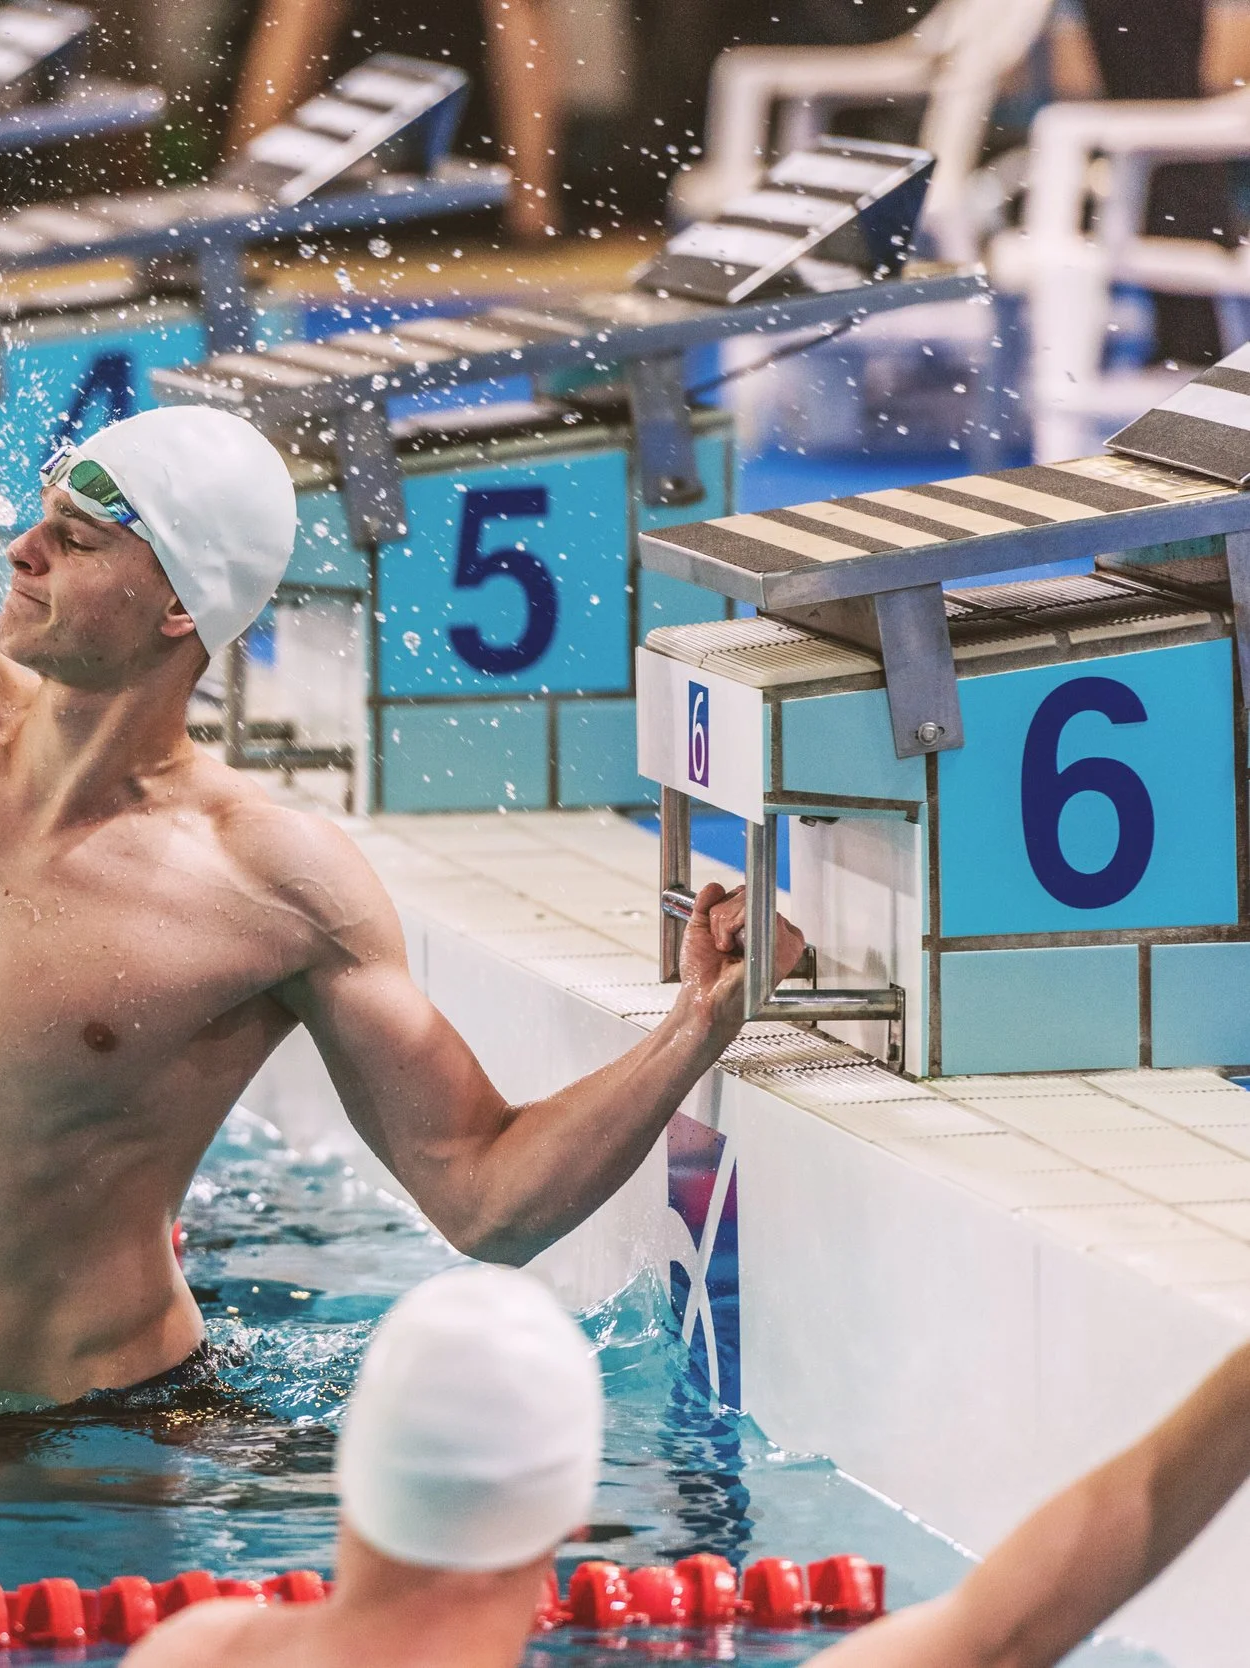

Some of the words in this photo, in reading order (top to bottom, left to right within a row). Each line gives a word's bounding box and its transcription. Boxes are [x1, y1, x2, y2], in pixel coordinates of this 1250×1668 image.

[448, 486, 559, 676] 5
[692, 691, 705, 781] 6
[1021, 676, 1155, 910] 6
